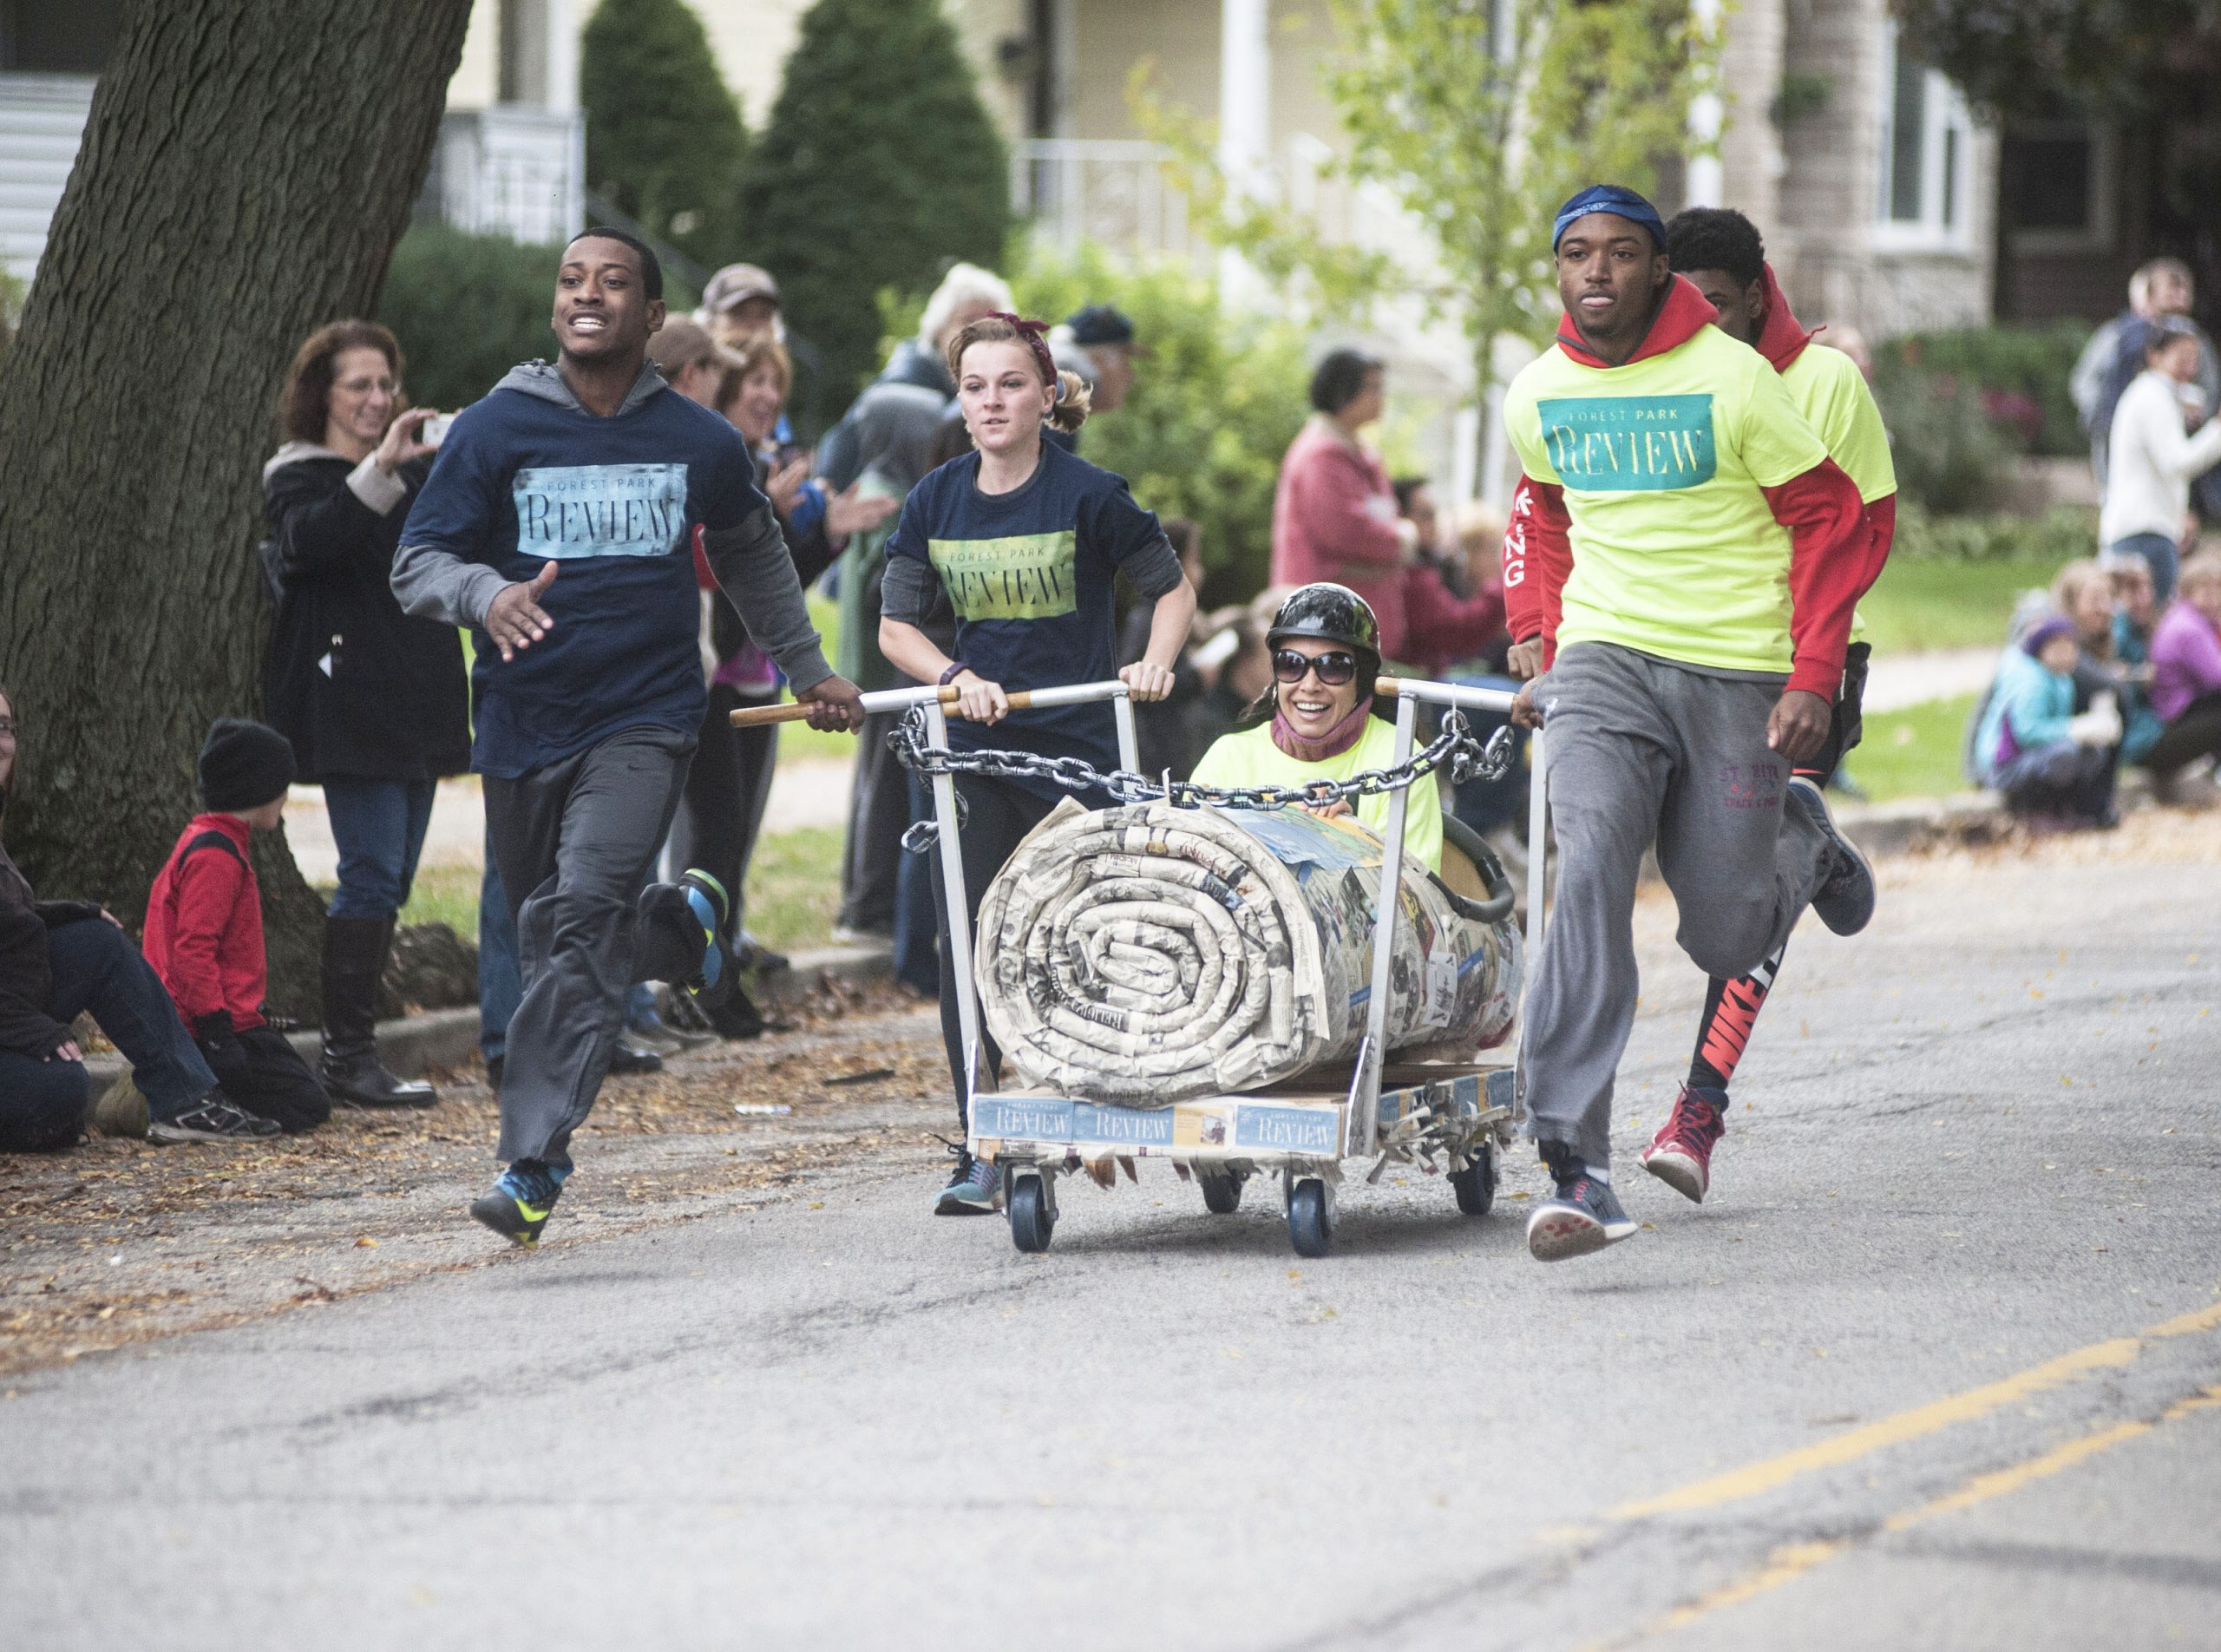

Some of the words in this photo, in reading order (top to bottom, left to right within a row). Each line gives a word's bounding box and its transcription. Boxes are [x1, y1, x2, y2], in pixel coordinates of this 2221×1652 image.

[1569, 410, 1627, 423] FOREST
[1635, 408, 1679, 421] PARK
[1551, 424, 1703, 475] REVIEW
[547, 479, 607, 492] FOREST
[617, 477, 656, 489] PARK
[526, 493, 678, 542] REVIEW
[949, 550, 1001, 562] FOREST
[1010, 547, 1046, 558] PARK
[946, 561, 1069, 608] REVIEW
[1700, 978, 1768, 1080] NIKE
[996, 1106, 1070, 1135] REVIEW
[1095, 1111, 1169, 1140] REVIEW
[1258, 1117, 1333, 1146] REVIEW
